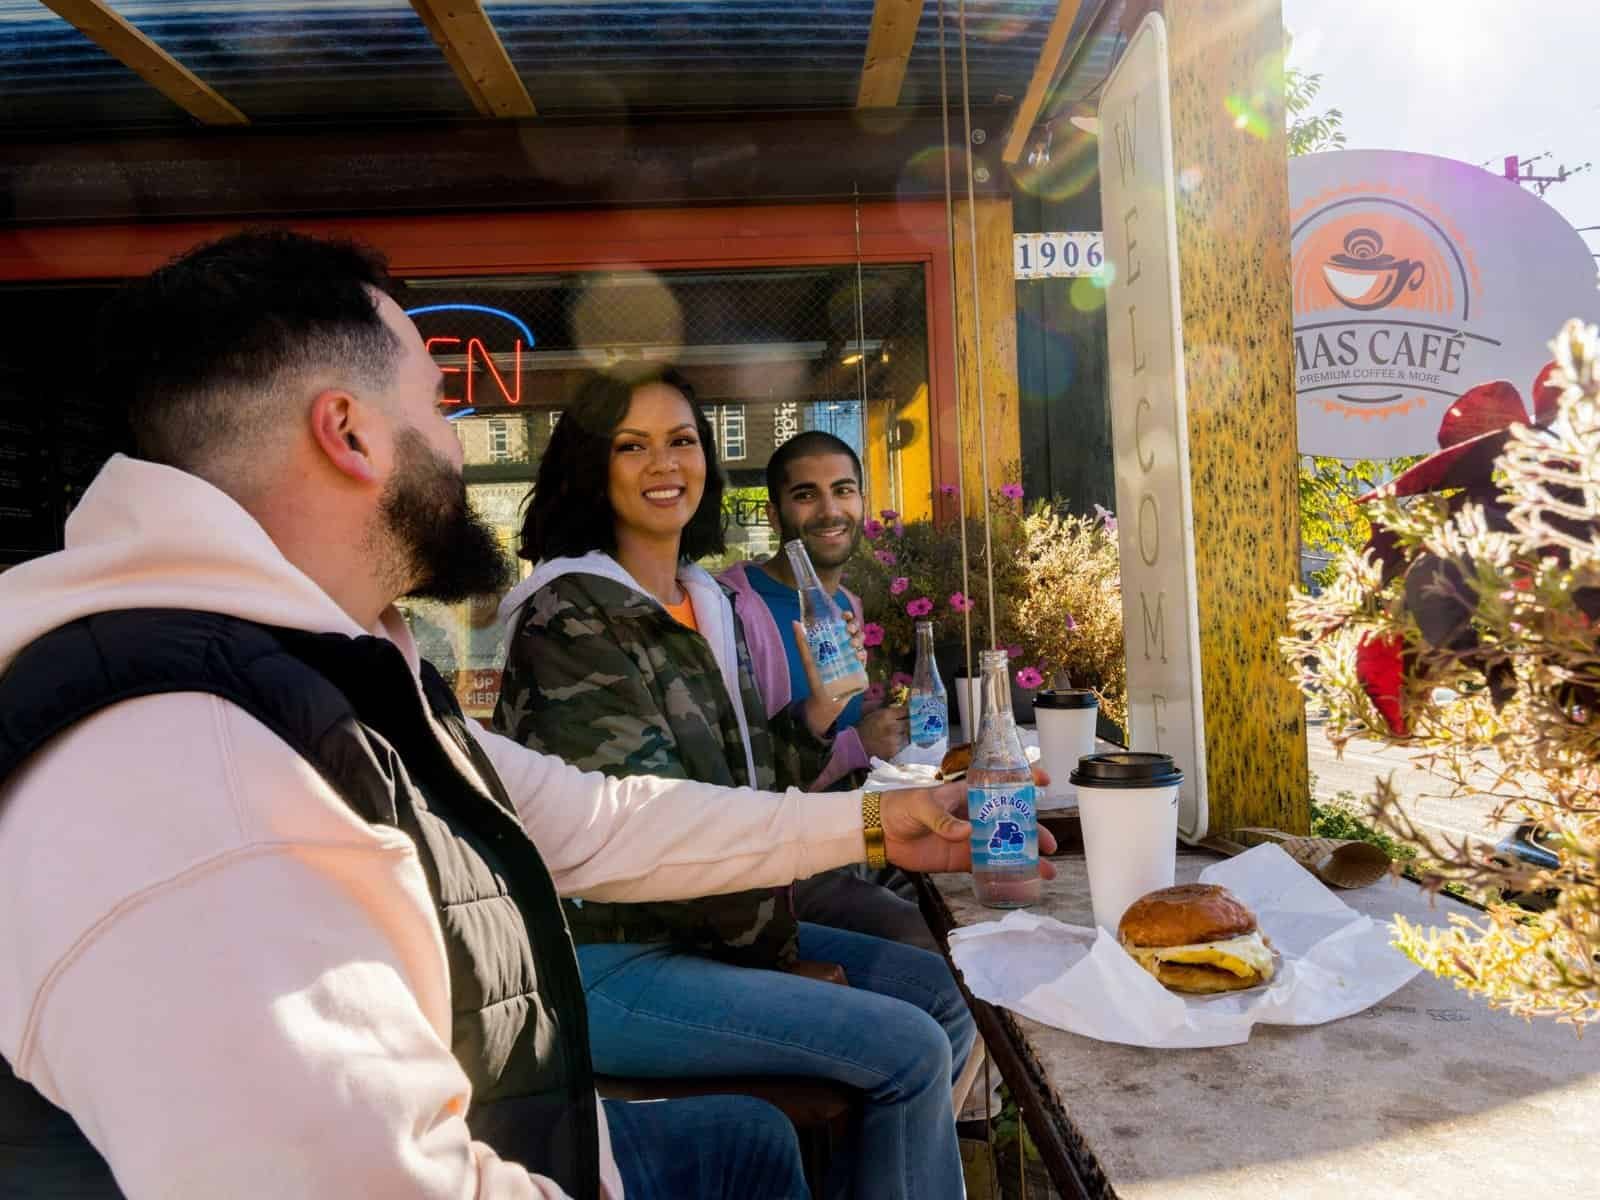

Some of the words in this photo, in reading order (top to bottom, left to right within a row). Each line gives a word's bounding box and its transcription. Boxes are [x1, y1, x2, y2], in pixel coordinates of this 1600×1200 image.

[1019, 241, 1102, 269] 1906
[1368, 328, 1465, 374] CAFÉ
[1300, 369, 1350, 385] PREMIUM
[1352, 368, 1396, 379] COFFEE
[1408, 370, 1441, 385] MORE
[1112, 94, 1168, 752] WELCOME
[473, 677, 494, 689] UP
